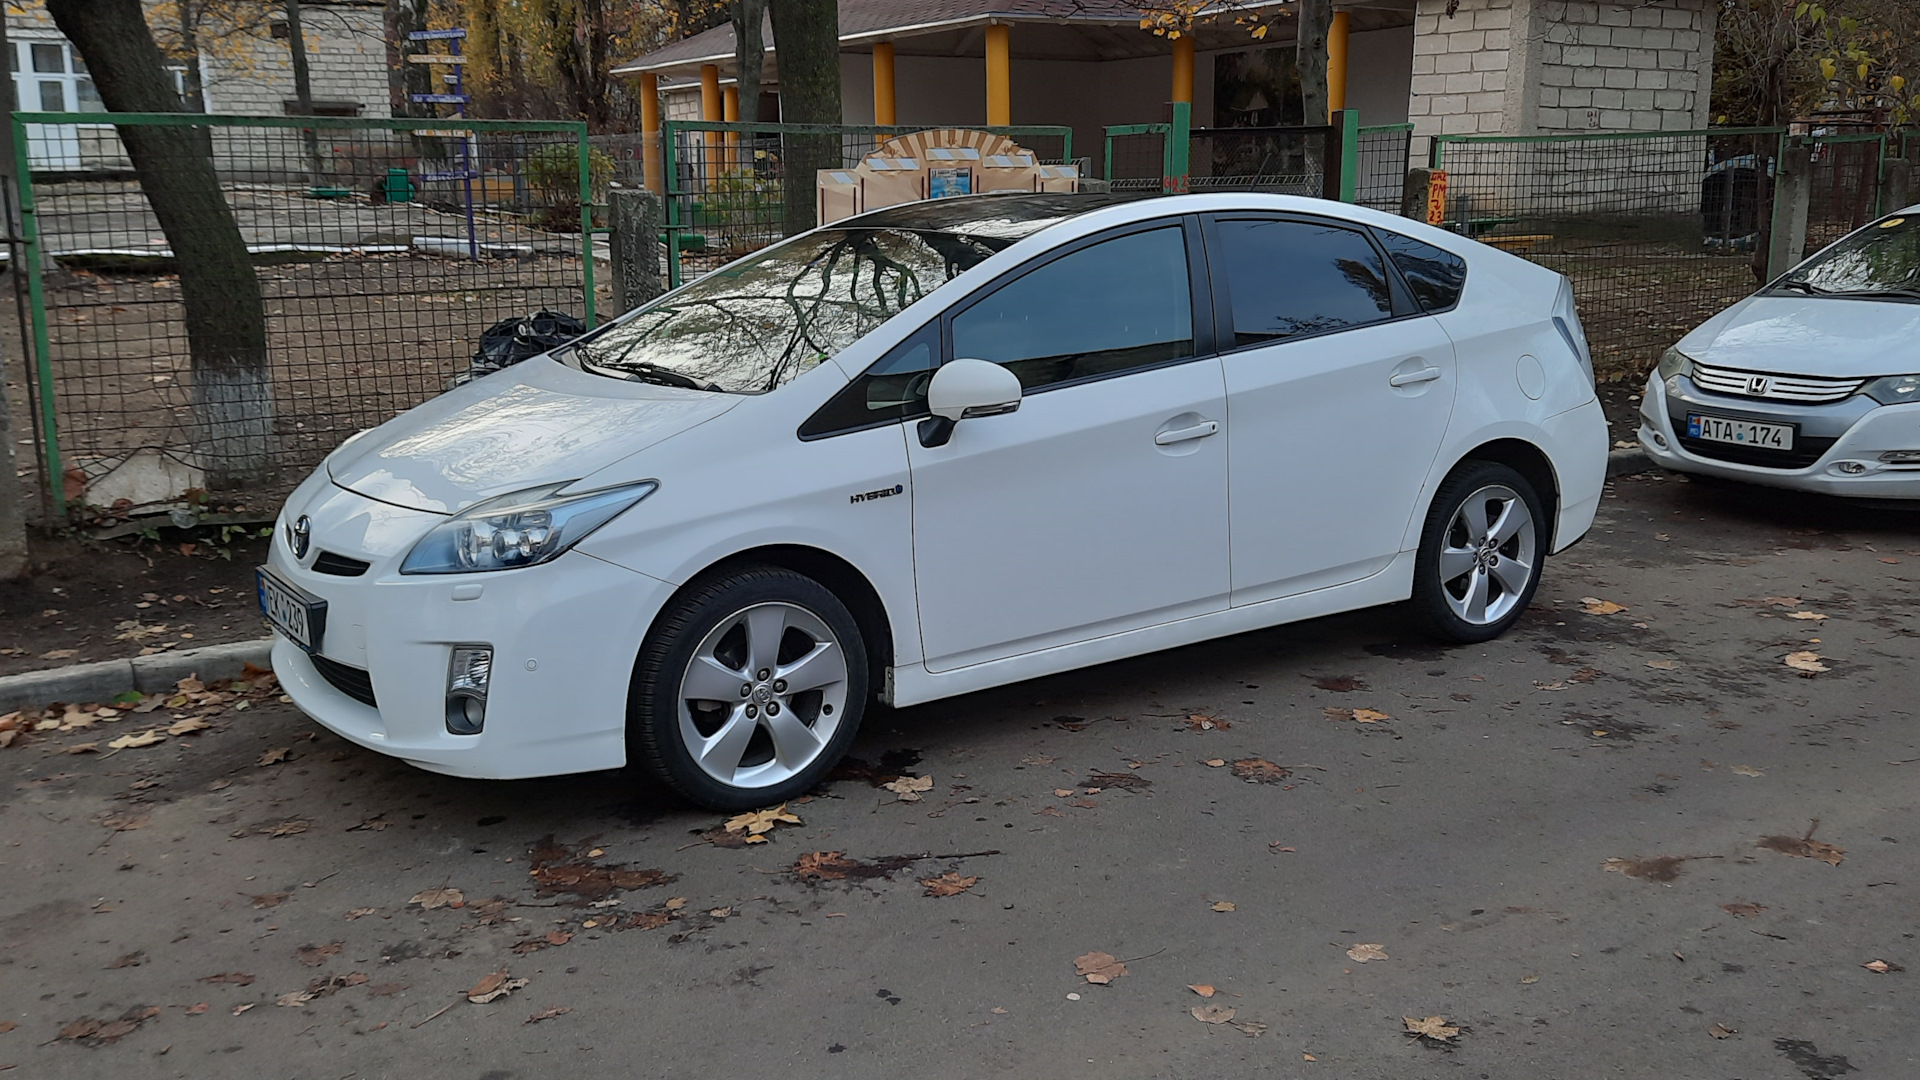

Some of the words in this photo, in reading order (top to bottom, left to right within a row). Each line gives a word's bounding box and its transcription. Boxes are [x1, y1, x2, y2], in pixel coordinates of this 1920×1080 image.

[1431, 171, 1448, 182] GAZ
[1432, 183, 1447, 199] PM
[850, 486, 896, 504] HYBRID
